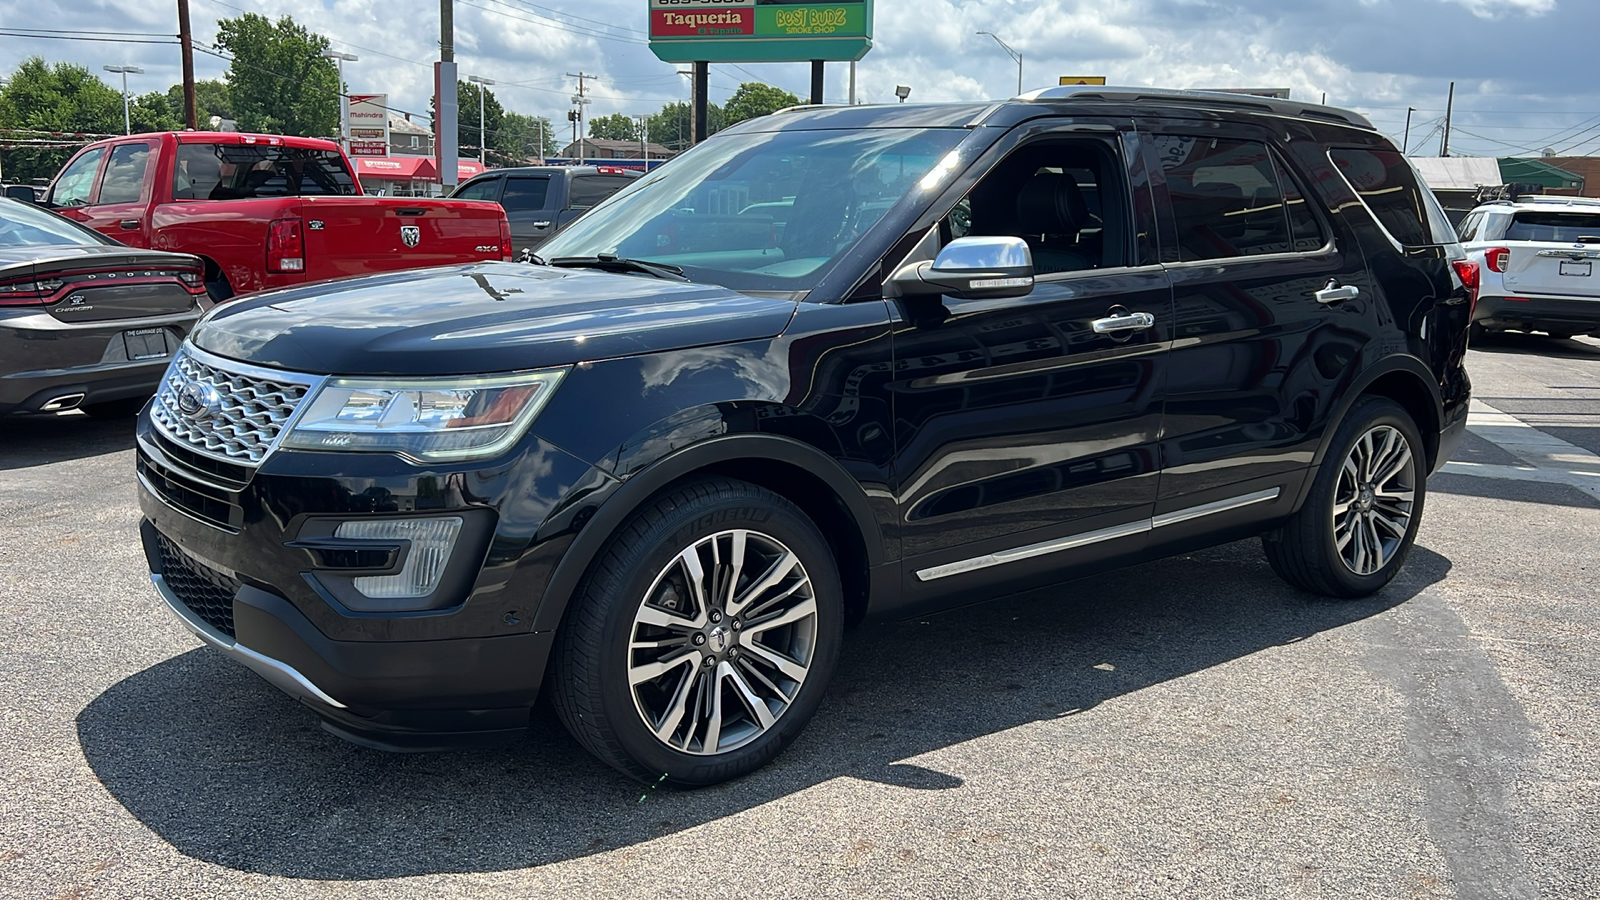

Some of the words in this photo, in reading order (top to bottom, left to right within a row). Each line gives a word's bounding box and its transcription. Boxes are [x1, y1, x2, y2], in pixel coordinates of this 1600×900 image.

[809, 8, 847, 27] BUDZ
[786, 26, 812, 34] SMOKE
[814, 26, 836, 34] SHOP
[88, 271, 166, 279] DODGE
[55, 305, 93, 313] CHARGER
[676, 507, 768, 541] MICHELIN
